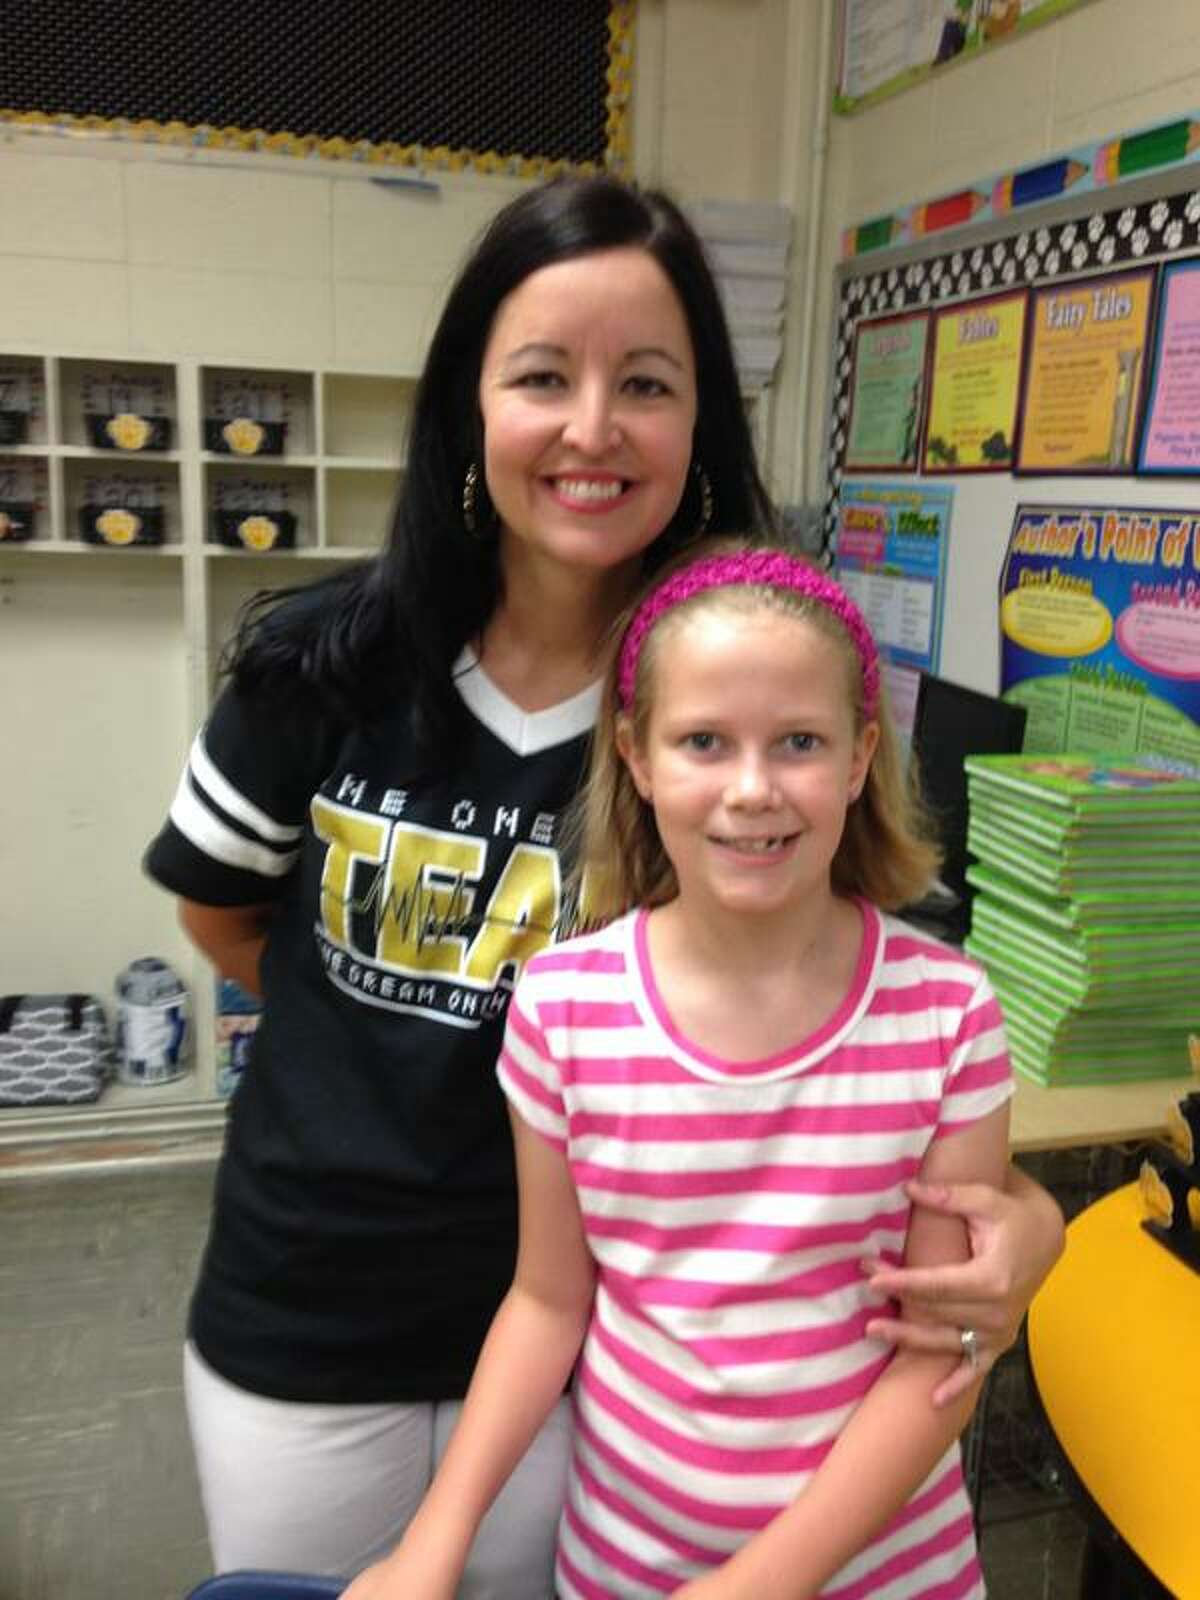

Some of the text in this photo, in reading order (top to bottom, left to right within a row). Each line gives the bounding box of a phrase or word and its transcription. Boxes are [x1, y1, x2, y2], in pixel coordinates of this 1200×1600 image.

[1012, 512, 1097, 560] Author's
[1099, 510, 1159, 565] Point
[1162, 514, 1192, 568] of
[311, 793, 600, 990] TEA
[348, 964, 438, 1005] DREAM
